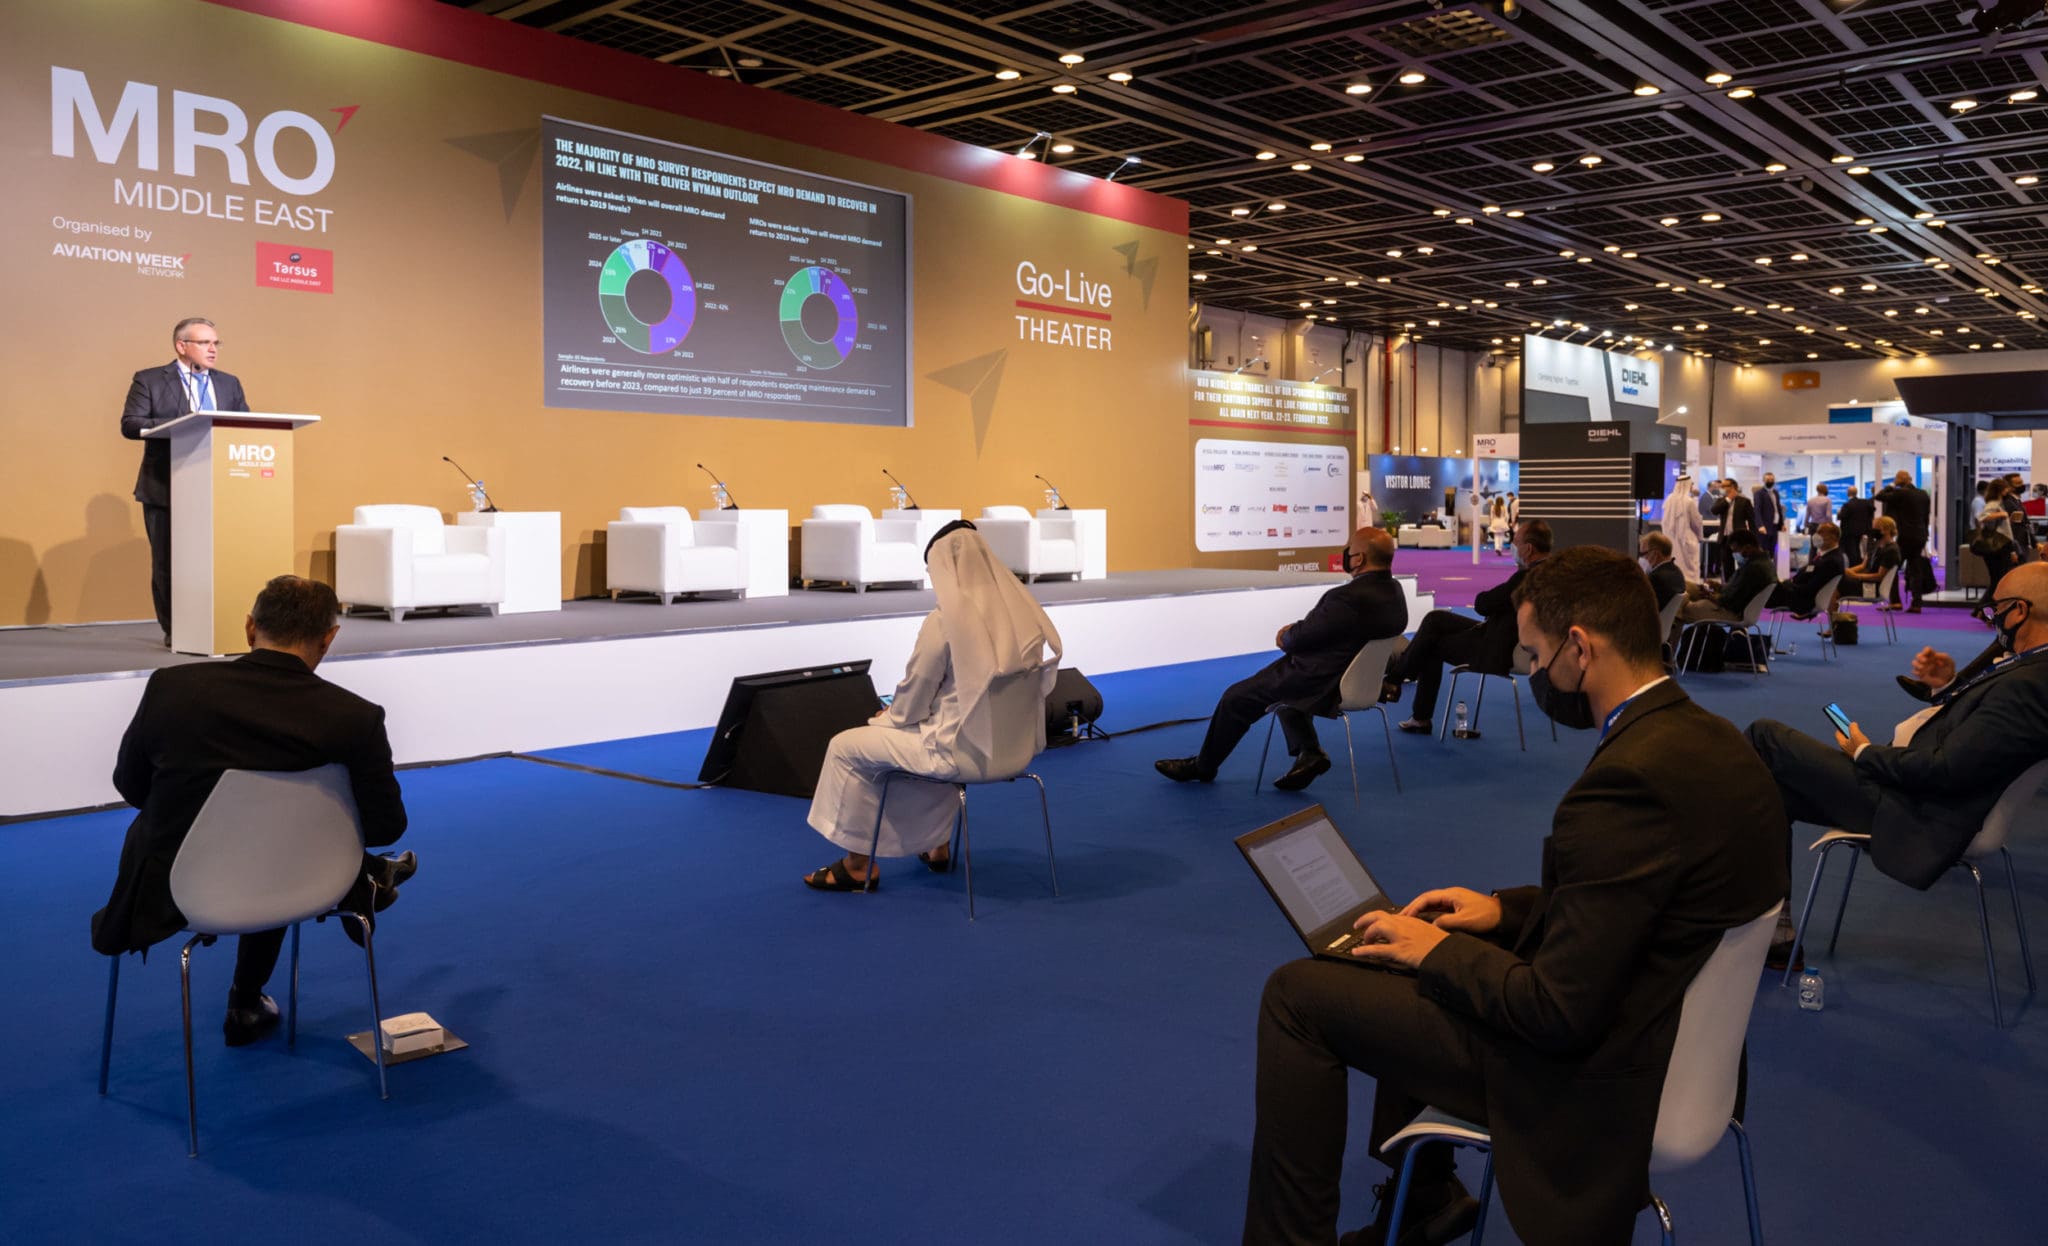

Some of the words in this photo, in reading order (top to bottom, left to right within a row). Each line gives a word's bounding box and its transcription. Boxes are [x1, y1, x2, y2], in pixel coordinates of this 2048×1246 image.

[51, 65, 336, 196] MRO
[555, 138, 574, 153] THE
[575, 142, 620, 163] MAJORITY
[622, 153, 634, 165] OF
[635, 155, 656, 170] MRO
[658, 160, 690, 177] SURVEY
[691, 166, 747, 189] RESPONDENTS
[748, 179, 776, 194] EXPECT
[777, 185, 795, 198] MRO
[796, 189, 825, 204] DEMAND
[827, 194, 836, 206] TO
[837, 196, 868, 213] RECOVER
[869, 202, 877, 214] IN
[555, 154, 583, 172] 2022,
[585, 160, 595, 173] IN
[597, 162, 617, 177] LINE
[619, 166, 641, 182] WITH
[643, 171, 659, 185] THE
[661, 175, 690, 191] OLIVER
[692, 181, 721, 197] WYMAN
[723, 187, 759, 205] OUTLOOK
[114, 178, 244, 222] MIDDLE
[255, 199, 334, 233] EAST
[556, 182, 583, 194] Airlines
[584, 189, 602, 198] were
[626, 195, 647, 206] When
[661, 202, 683, 212] overall
[684, 205, 700, 215] MRO
[701, 209, 726, 220] demand
[556, 195, 579, 205] return
[580, 198, 589, 206] to
[590, 199, 607, 210] 2019
[52, 215, 130, 238] Organised
[135, 224, 152, 242] by
[52, 242, 131, 264] AVIATION
[135, 251, 184, 270] WEEK
[137, 265, 185, 280] NETWORK
[273, 261, 318, 278] Tarsus
[1016, 260, 1112, 308] Go-Live
[1015, 315, 1112, 351] THEATER
[560, 364, 590, 374] Airlines
[591, 368, 611, 376] were
[612, 369, 645, 380] generally
[646, 372, 666, 380] more
[666, 373, 700, 383] optimistic
[701, 375, 716, 383] with
[718, 376, 730, 385] half
[739, 380, 778, 389] respondents
[779, 382, 808, 392] expecting
[808, 384, 846, 394] maintenance
[846, 386, 869, 395] demand
[869, 388, 876, 396] to
[1622, 368, 1648, 386] DIEHL
[560, 378, 595, 389] recovery
[596, 378, 621, 389] before
[643, 384, 680, 393] compared
[688, 385, 702, 395] just
[703, 387, 712, 395] 39
[712, 388, 738, 398] percent
[738, 389, 746, 397] of
[746, 390, 763, 399] MRO
[764, 392, 801, 401] respondents
[1477, 438, 1496, 447] MRO
[1588, 429, 1622, 437] DIEHL
[1722, 431, 1746, 440] MRO
[228, 443, 276, 461] MRO
[1993, 457, 2029, 465] Capability
[1385, 474, 1409, 489] VISITOR
[1410, 475, 1431, 490] LOUNGE
